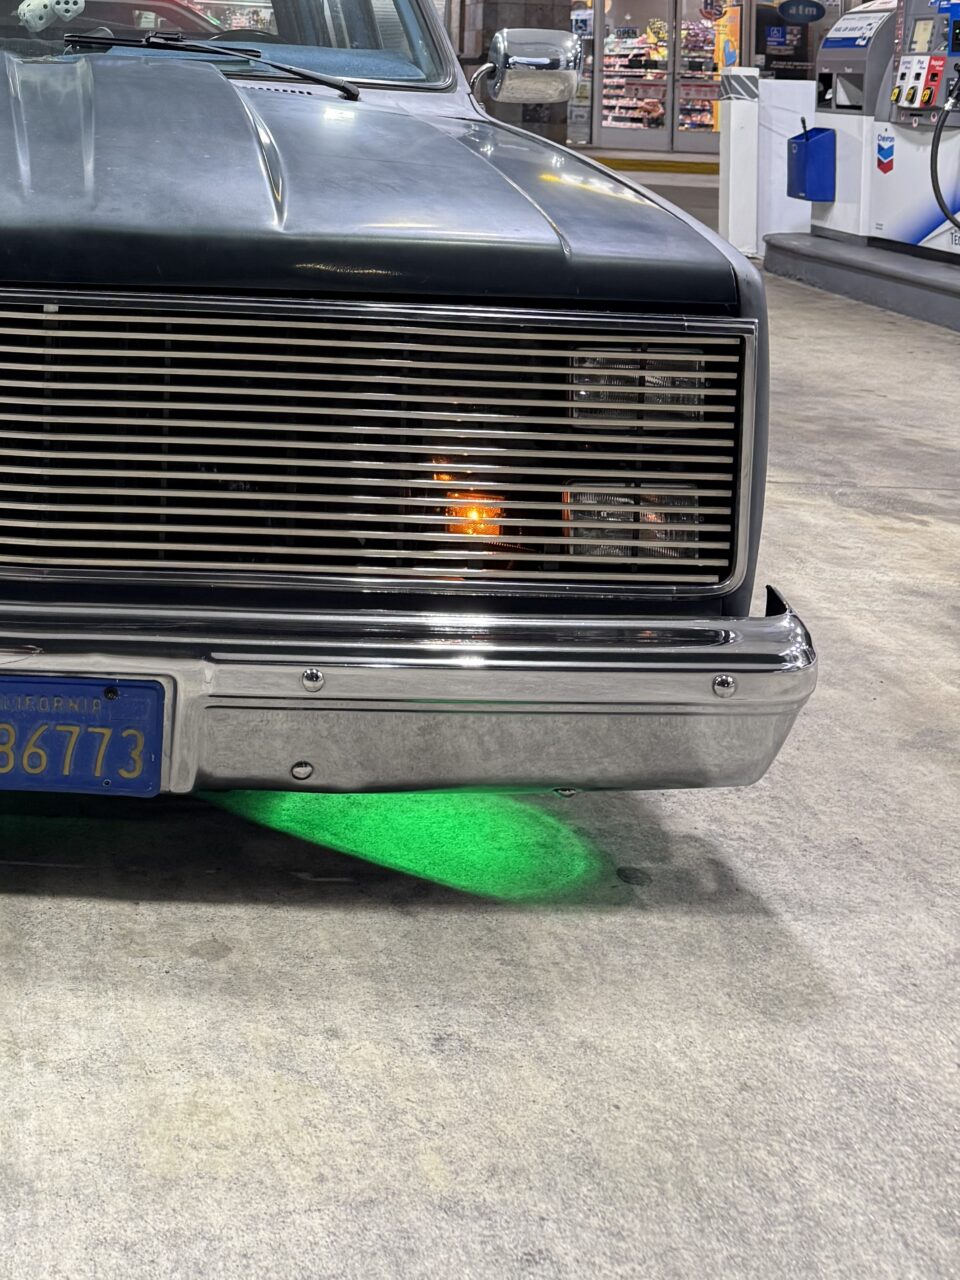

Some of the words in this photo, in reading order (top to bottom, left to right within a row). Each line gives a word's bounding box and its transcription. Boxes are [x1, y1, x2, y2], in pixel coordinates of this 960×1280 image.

[788, 6, 817, 17] atm
[616, 29, 637, 38] OPEN
[878, 134, 895, 143] Chevron
